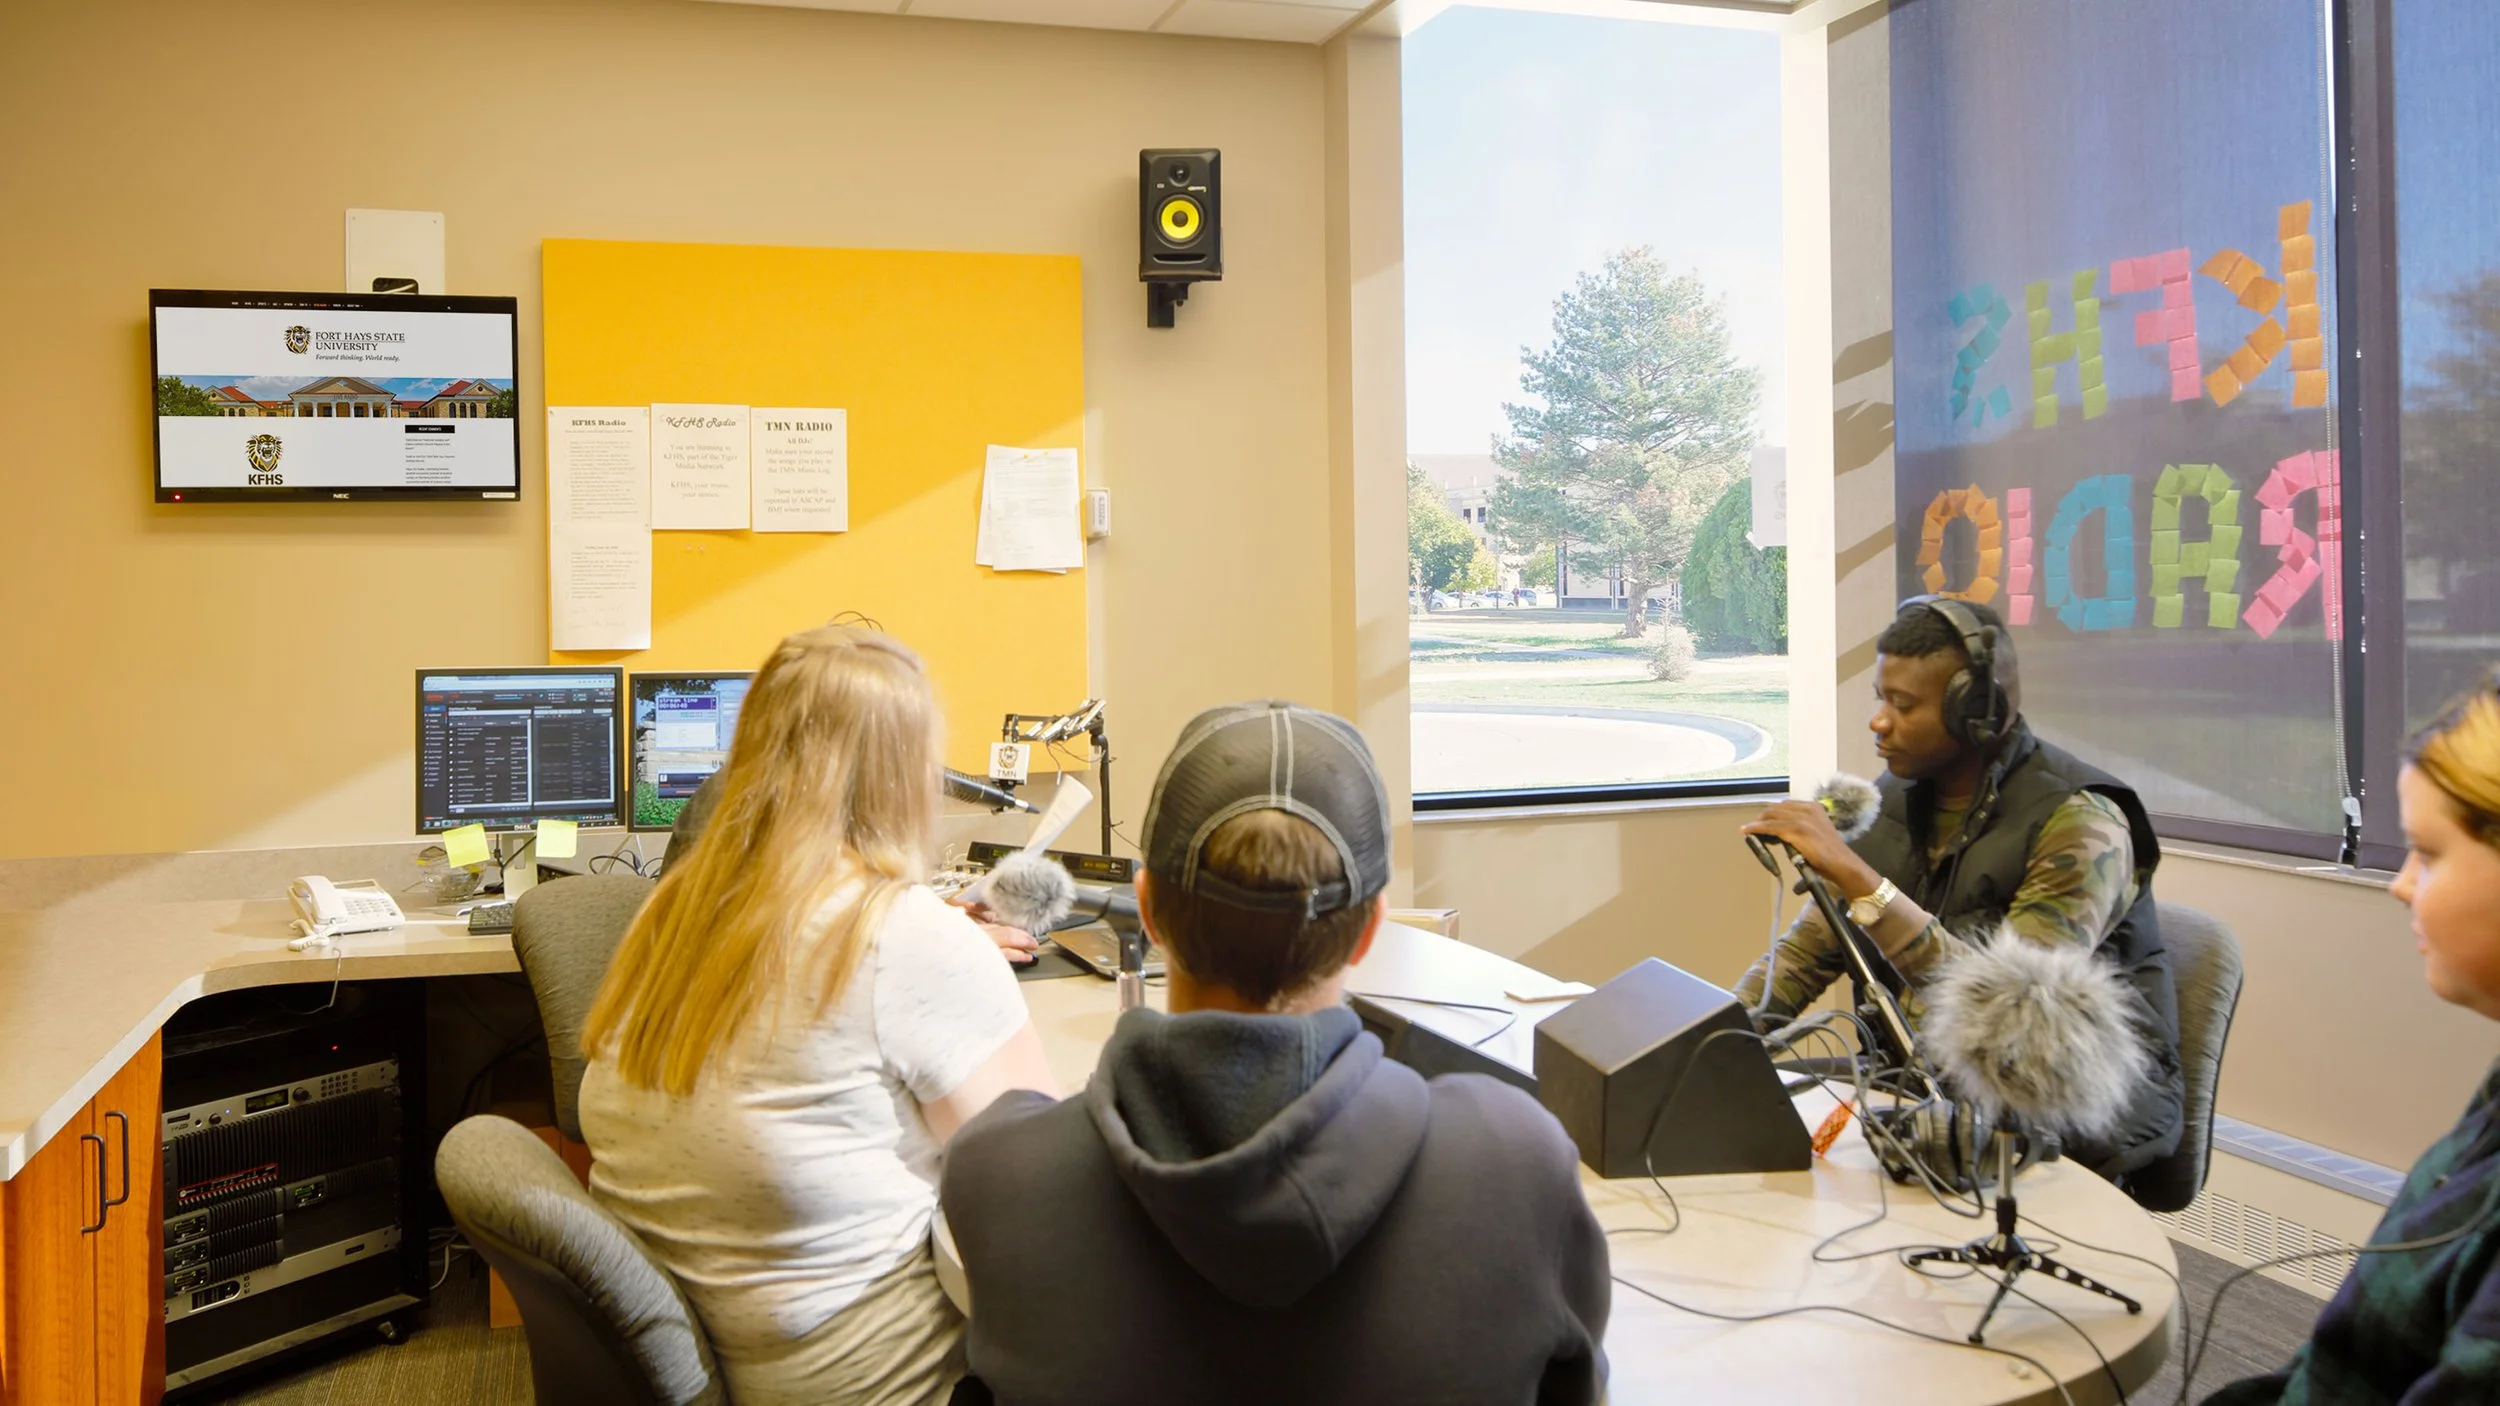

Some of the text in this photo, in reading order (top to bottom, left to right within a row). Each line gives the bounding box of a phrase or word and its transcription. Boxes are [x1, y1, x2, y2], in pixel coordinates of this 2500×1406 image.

[315, 331, 405, 341] FORT HAYS STATE
[315, 341, 378, 351] UNIVERSITY
[315, 353, 339, 361] Forward
[340, 354, 364, 362] thinking.
[706, 417, 736, 429] Radio
[765, 421, 833, 431] TMN RADIO
[248, 473, 284, 486] KFHS
[997, 769, 1017, 778] TMN
